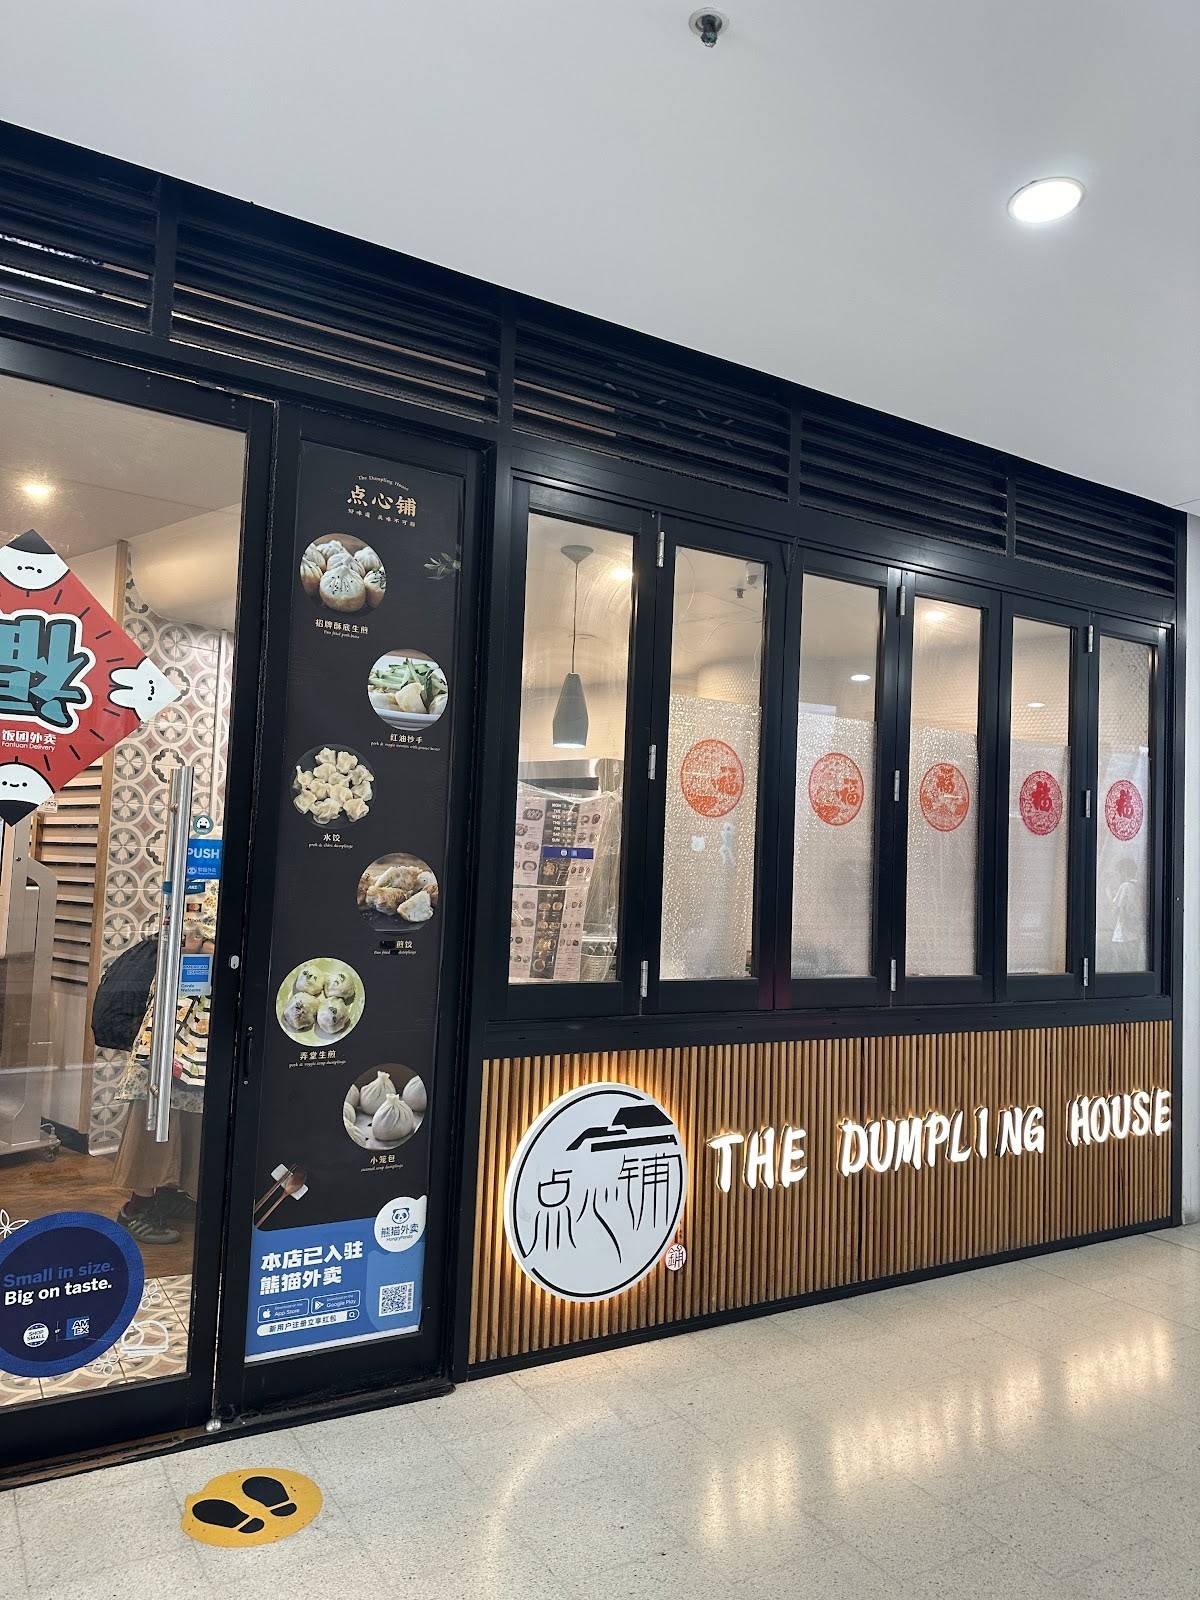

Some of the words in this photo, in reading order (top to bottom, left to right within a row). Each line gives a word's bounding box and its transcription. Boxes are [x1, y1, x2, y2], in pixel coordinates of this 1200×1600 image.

[347, 485, 416, 517] 点心铺
[1, 741, 28, 749] Fantuan
[29, 742, 56, 752] Delivery
[2, 729, 57, 745] 饭团外卖
[323, 833, 340, 842] 水饺
[707, 1126, 808, 1193] THE
[838, 1105, 1045, 1177] DUMPLING
[1067, 1088, 1173, 1147] HOUSE
[526, 1153, 681, 1263] 点心铺
[381, 1223, 419, 1238] 熊猫外卖
[261, 1241, 364, 1272] 本店已入驻
[3, 1268, 53, 1287] Small
[58, 1266, 73, 1279] in
[79, 1262, 115, 1276] size.
[260, 1266, 342, 1295] 熊猫外卖
[5, 1290, 34, 1306] Big
[38, 1286, 60, 1300] on
[65, 1278, 112, 1295] taste.
